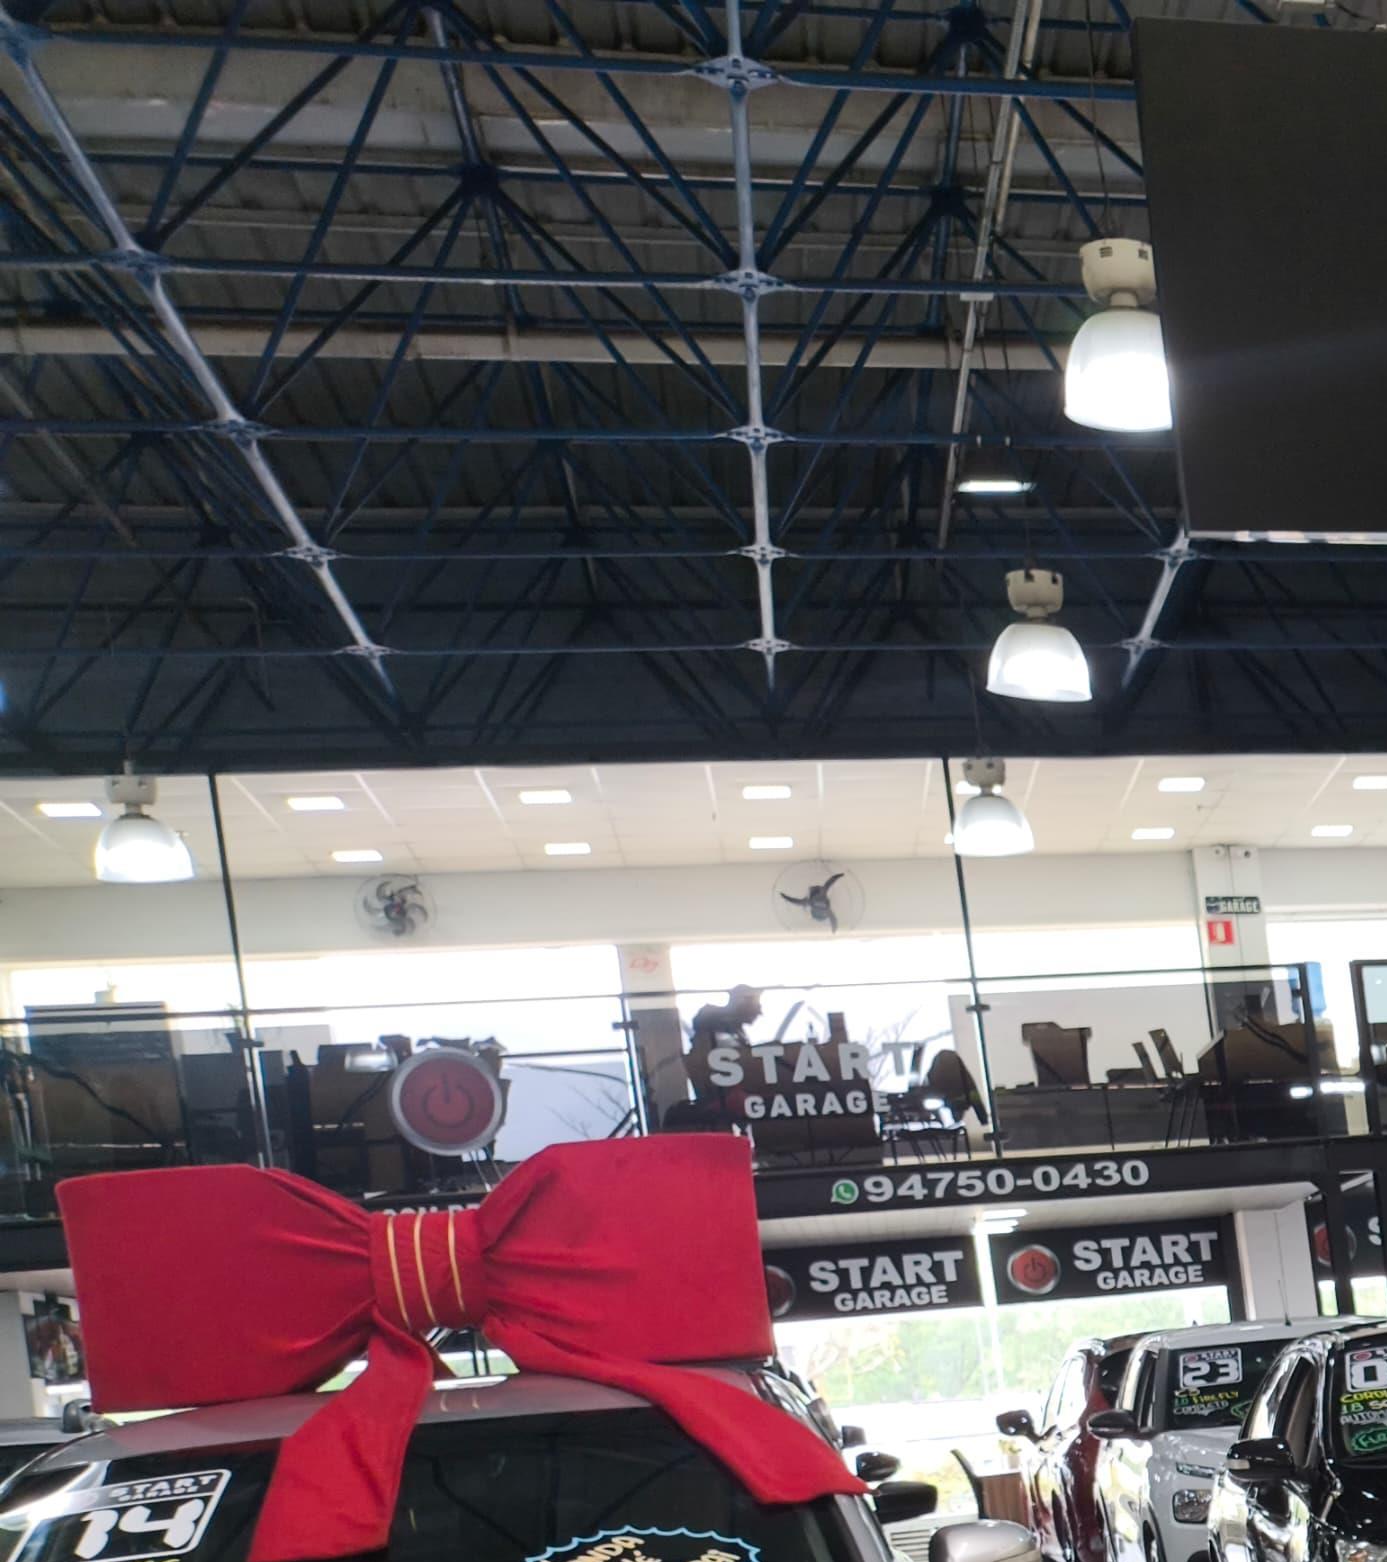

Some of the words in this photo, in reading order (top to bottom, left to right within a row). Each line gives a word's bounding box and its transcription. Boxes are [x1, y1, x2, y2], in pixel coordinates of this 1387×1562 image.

[707, 1041, 917, 1087] START
[744, 1090, 891, 1118] GARAGE
[865, 1159, 1149, 1202] 94750-0430
[1073, 1232, 1218, 1272] START
[809, 1250, 963, 1293] START
[1097, 1264, 1204, 1291] GARAGE
[834, 1284, 948, 1313] GARAGE
[1183, 1359, 1239, 1387] 23
[109, 1474, 219, 1499] START
[74, 1499, 205, 1559] 14
